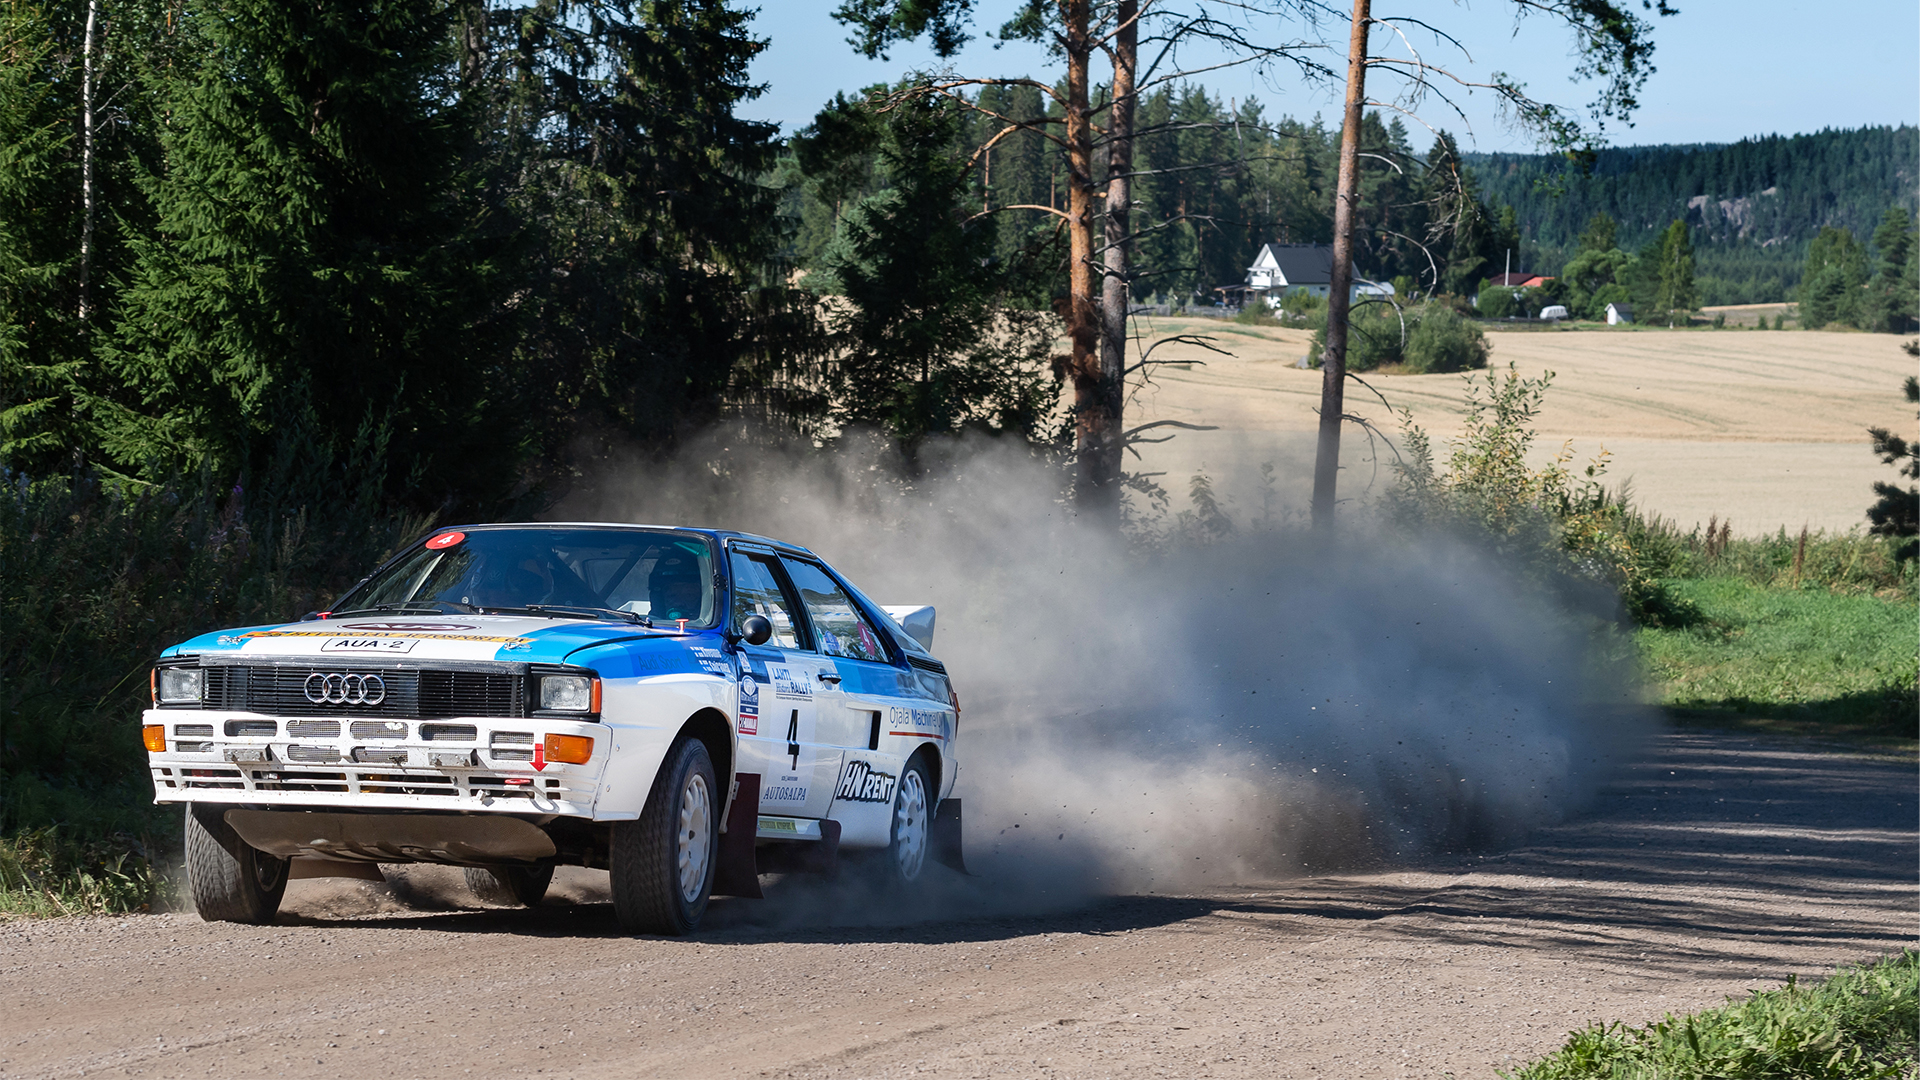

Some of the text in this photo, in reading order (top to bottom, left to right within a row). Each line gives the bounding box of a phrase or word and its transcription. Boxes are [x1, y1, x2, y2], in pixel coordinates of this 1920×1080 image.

[437, 534, 455, 545] 4
[861, 627, 871, 646] 4
[638, 653, 685, 673] Audi Sport
[771, 667, 792, 681] LAHTI
[790, 681, 810, 695] RALLY
[889, 706, 909, 728] Ojala
[786, 710, 800, 771] 4
[836, 760, 896, 803] HN RENT
[762, 786, 807, 801] AUTOSALPA
